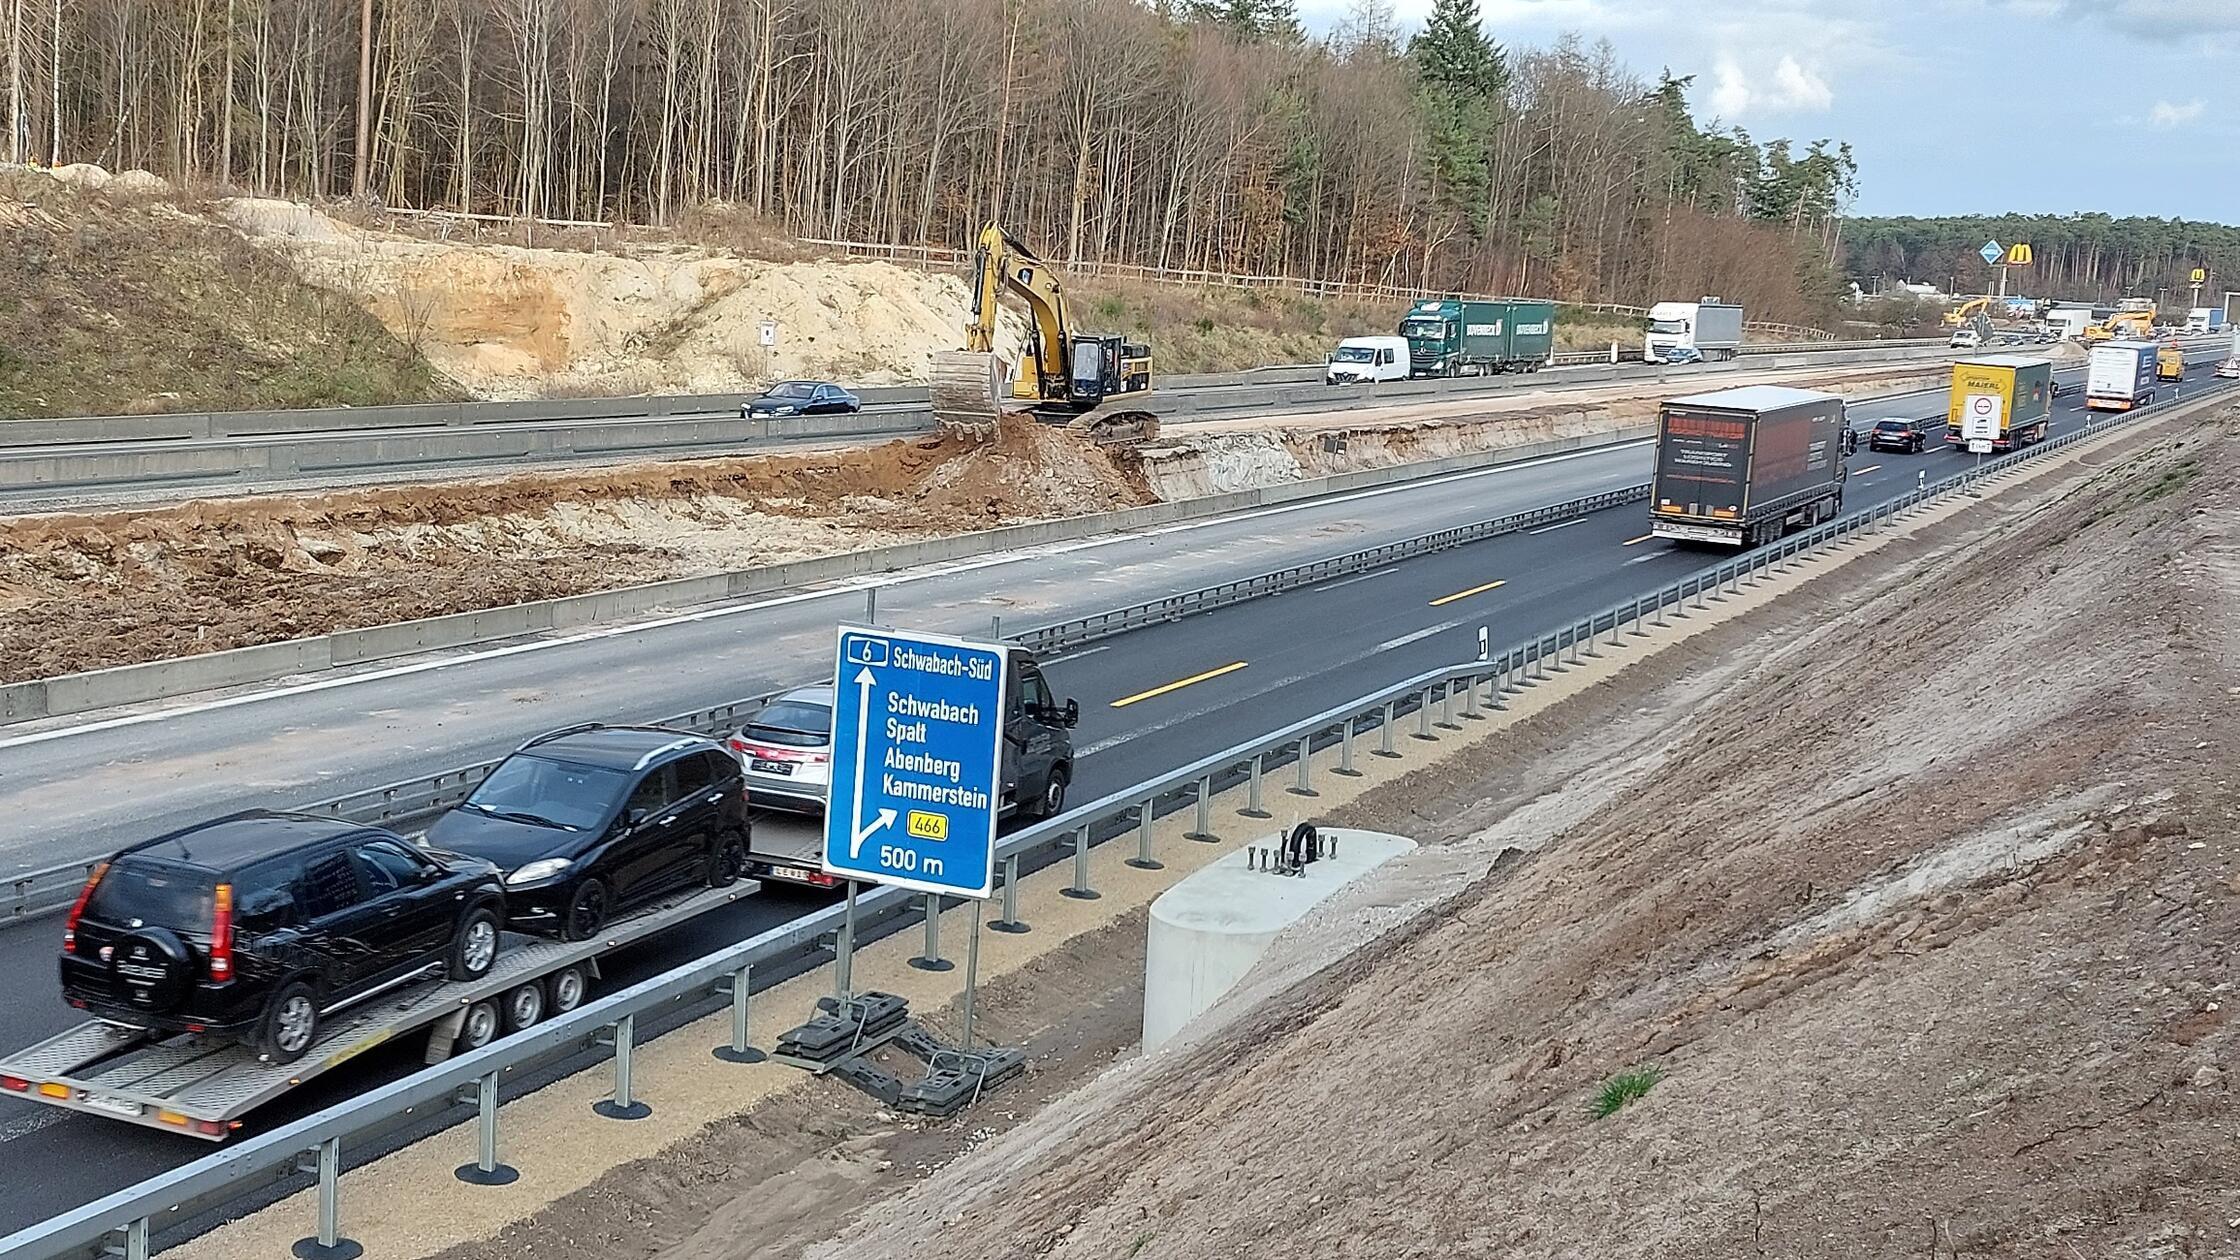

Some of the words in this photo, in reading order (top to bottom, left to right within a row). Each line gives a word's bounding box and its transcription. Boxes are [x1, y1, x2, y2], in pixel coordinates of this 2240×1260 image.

[862, 638, 872, 661] 6
[893, 646, 992, 681] Schwabach-Süd
[887, 691, 979, 725] Schwabach
[886, 717, 927, 745] Spalt
[884, 746, 961, 783] Abenberg
[882, 772, 988, 810] Kammerstein
[915, 816, 941, 834] 466
[880, 845, 917, 871] 500
[922, 857, 944, 876] m
